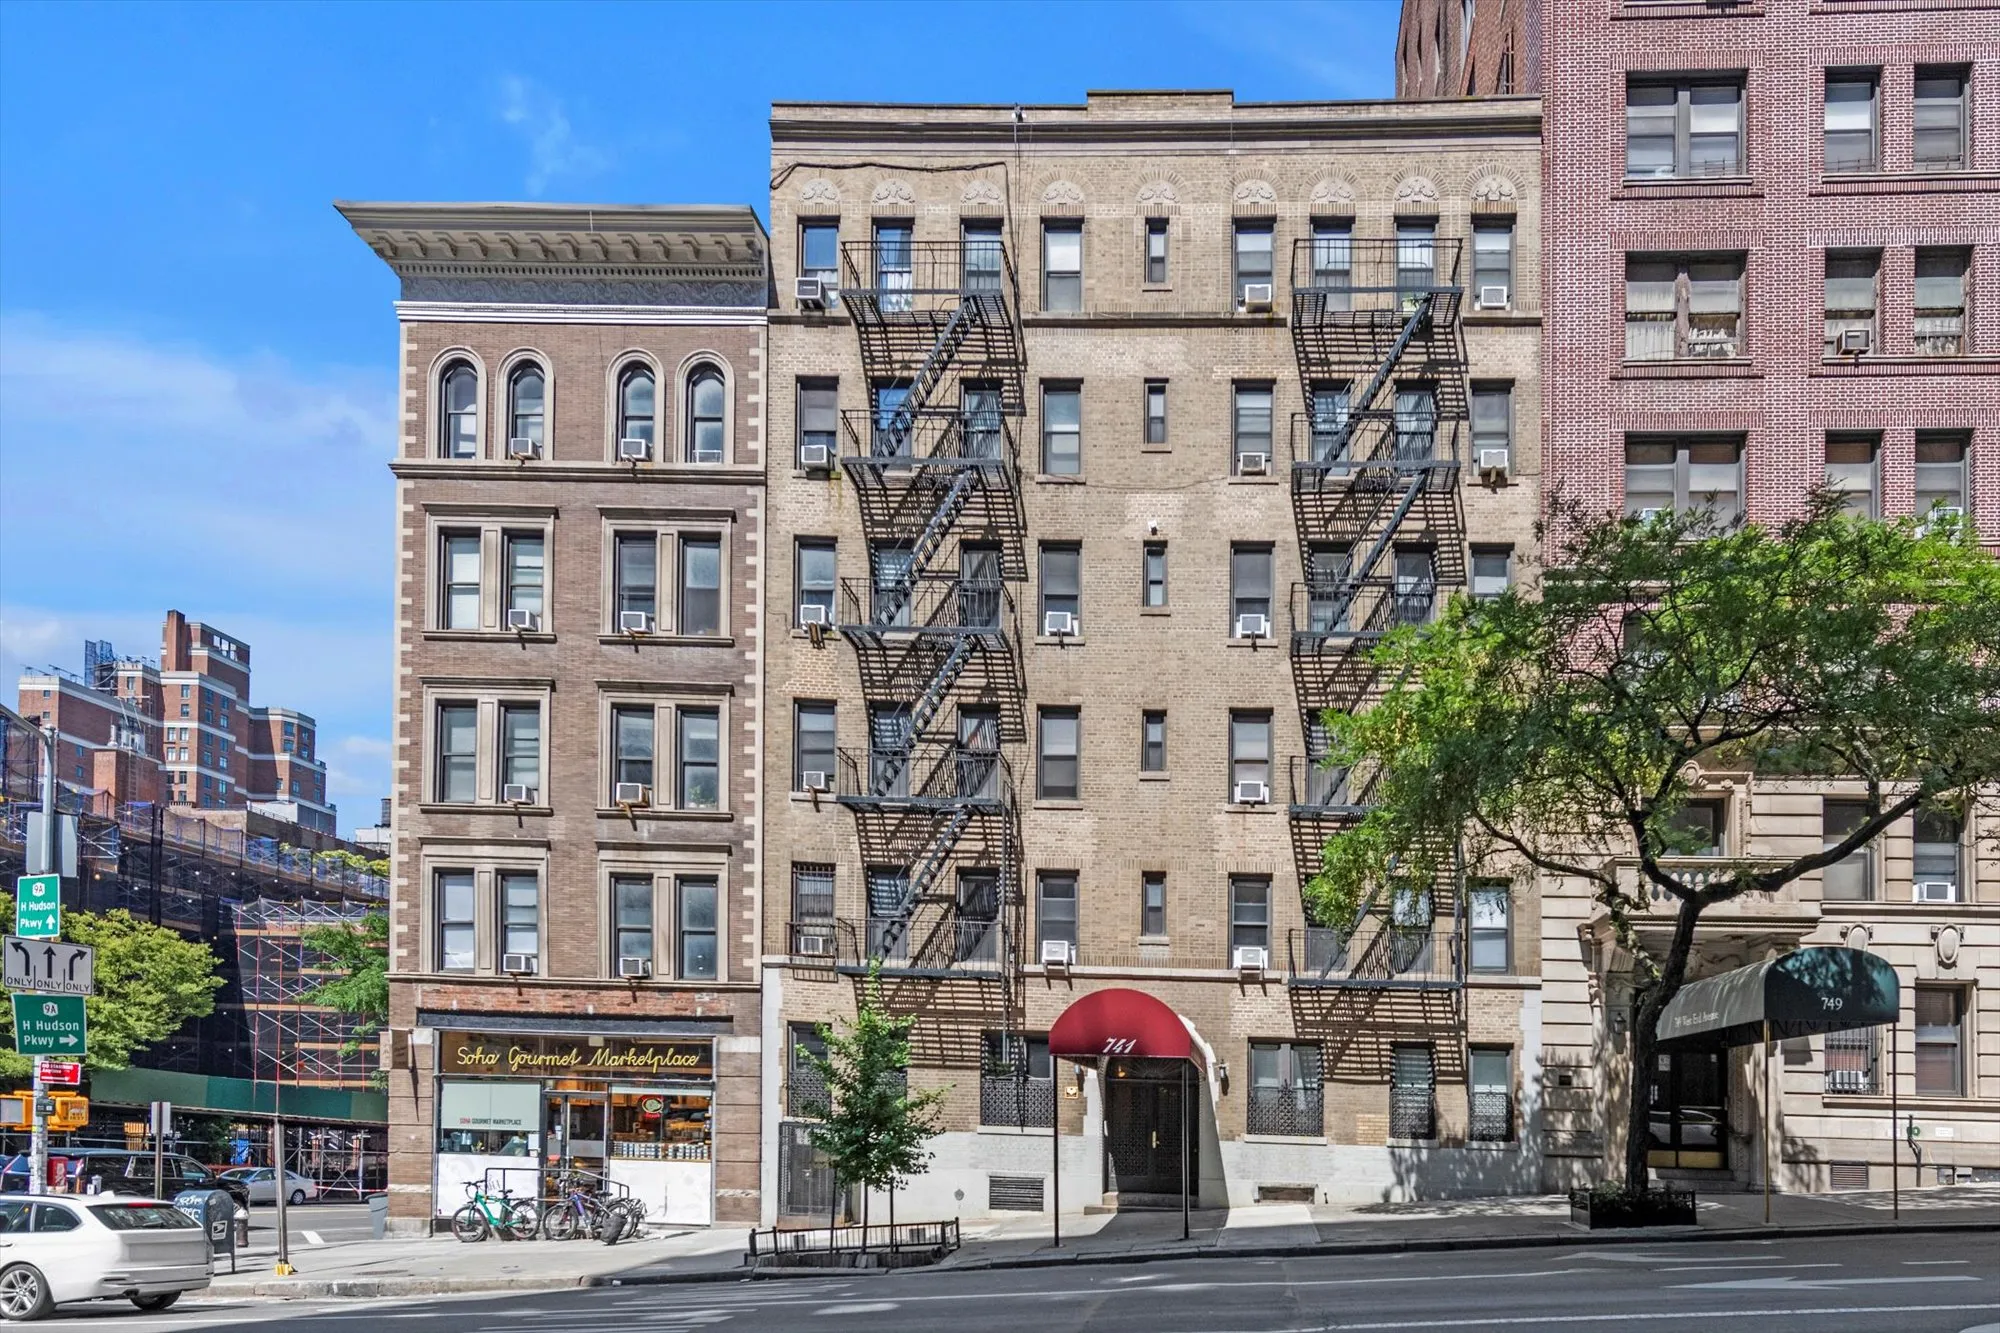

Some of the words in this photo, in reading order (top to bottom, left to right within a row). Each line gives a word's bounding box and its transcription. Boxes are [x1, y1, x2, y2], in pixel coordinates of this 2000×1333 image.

[34, 884, 44, 894] 9A
[21, 902, 27, 912] H
[29, 901, 56, 911] Hudson
[20, 918, 43, 930] Pkwy
[7, 977, 32, 986] ONLY
[37, 980, 61, 990] ONLY
[66, 983, 90, 992] ONLY
[44, 1004, 56, 1013] 9A
[1821, 997, 1843, 1011] 749
[23, 1021, 30, 1030] H
[36, 1020, 79, 1031] Hudson
[24, 1035, 54, 1047] Pkwy
[1102, 1037, 1137, 1053] 741
[457, 1046, 500, 1065] Soha
[508, 1046, 582, 1072] Gourmet
[587, 1047, 699, 1074] Marketplace
